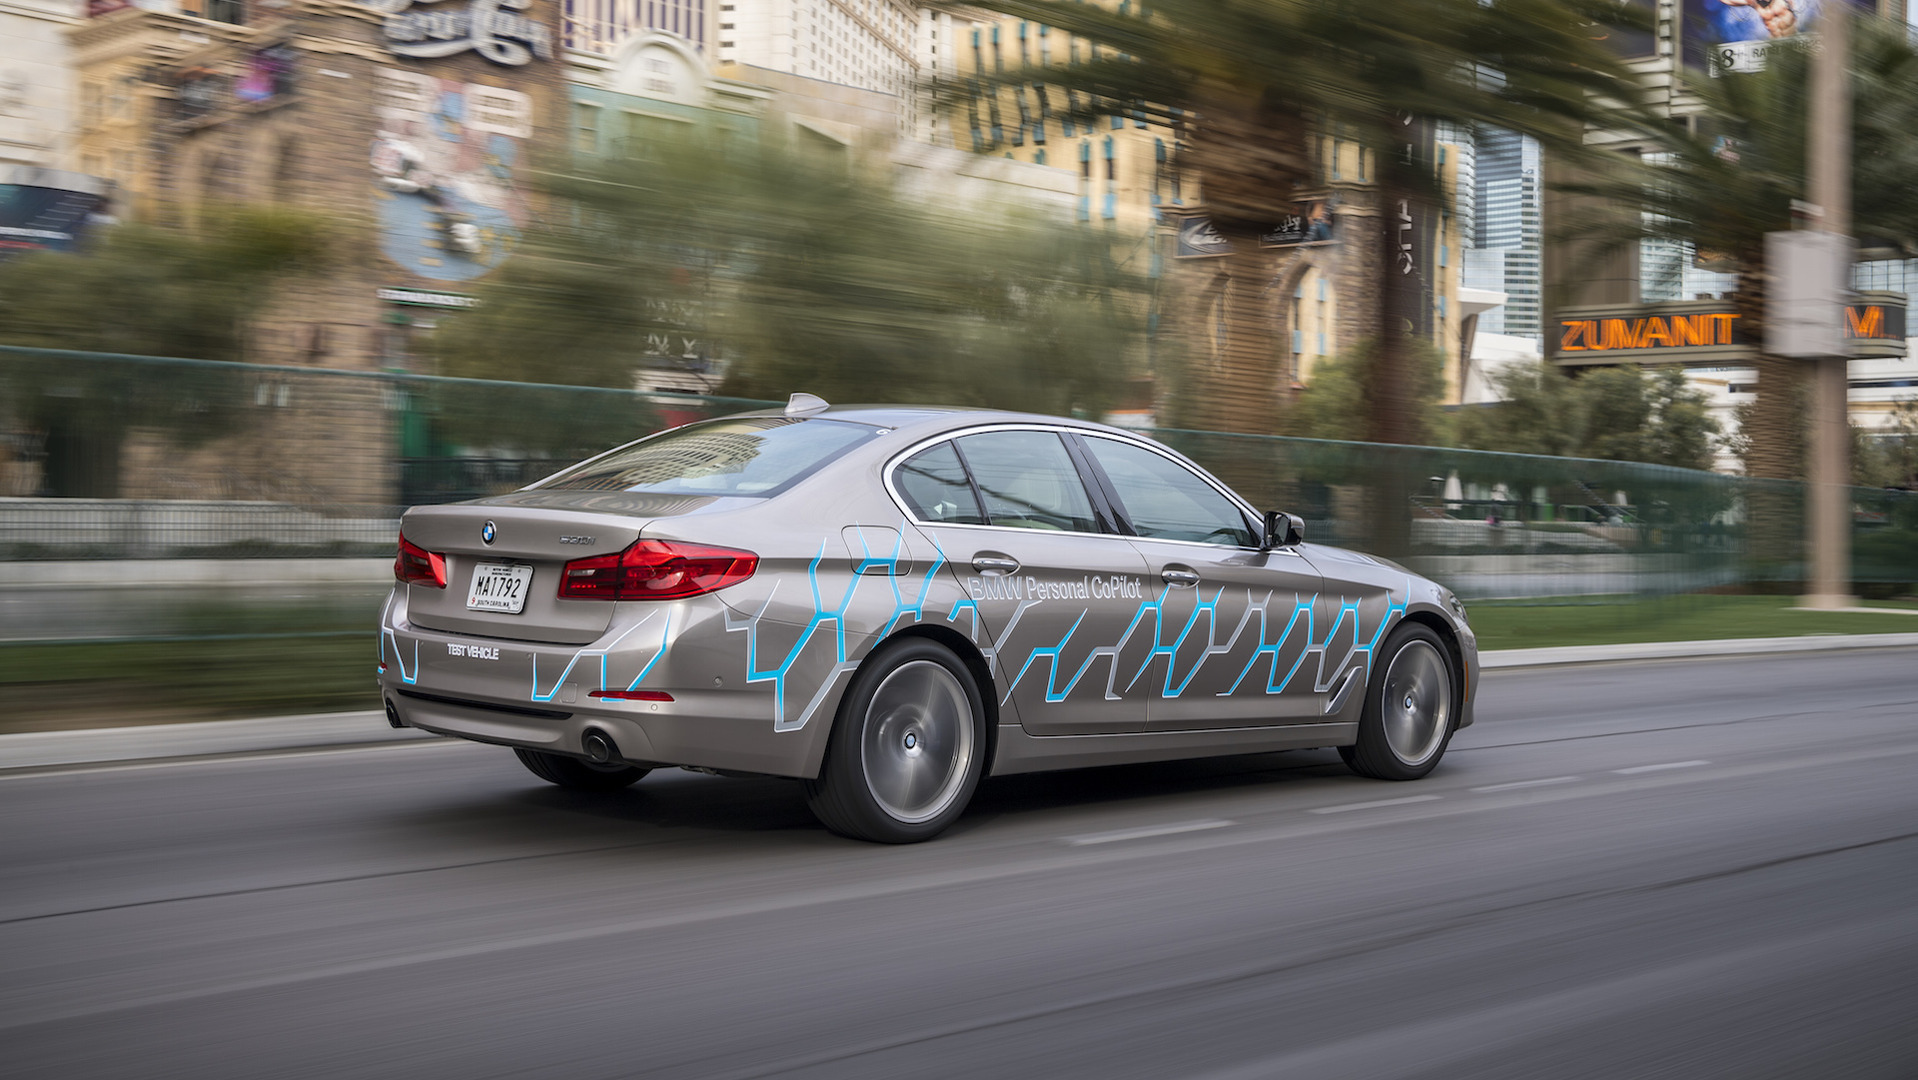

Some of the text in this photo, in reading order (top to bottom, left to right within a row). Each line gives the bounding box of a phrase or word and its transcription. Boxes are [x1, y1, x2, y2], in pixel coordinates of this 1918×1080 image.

[1561, 313, 1742, 351] ZUMANIT
[475, 576, 521, 598] MA1792
[967, 575, 1143, 600] BMW Personal CoPilot
[447, 643, 500, 660] TEST VEHICLE
